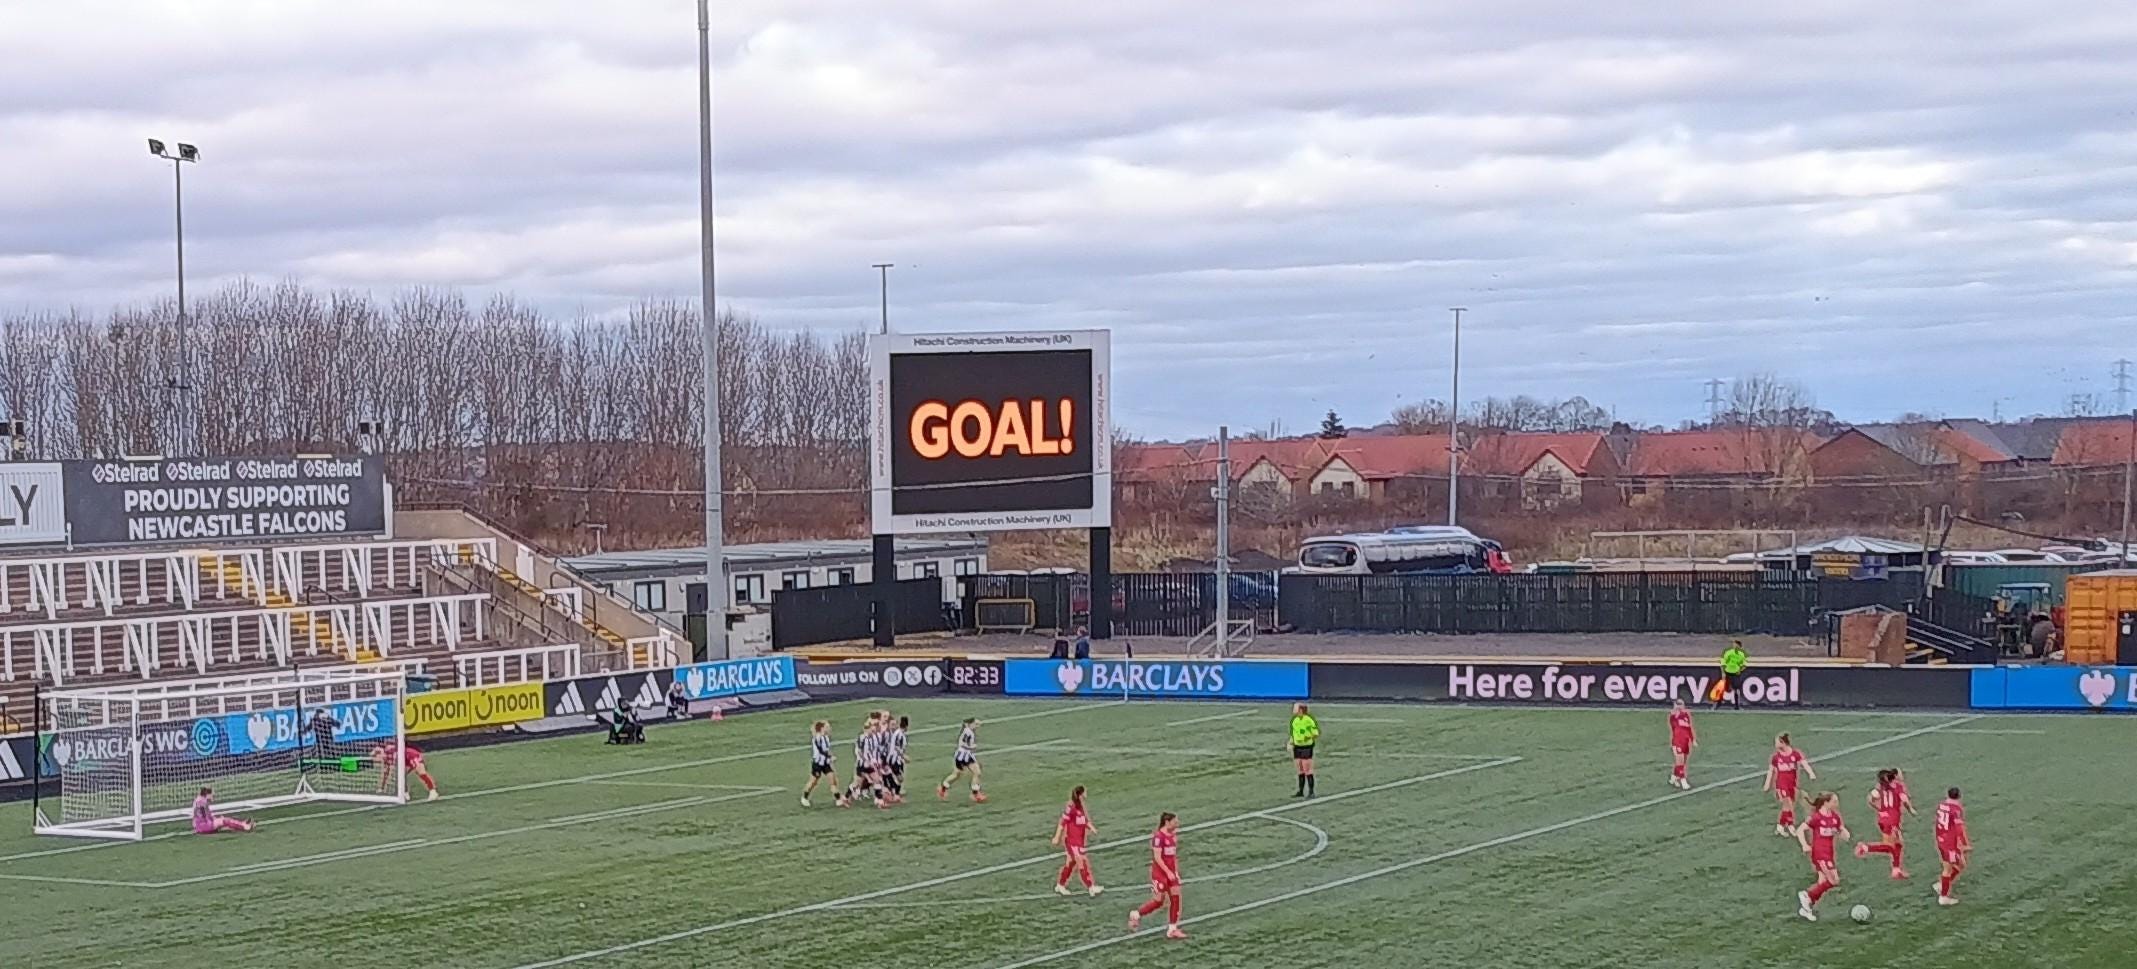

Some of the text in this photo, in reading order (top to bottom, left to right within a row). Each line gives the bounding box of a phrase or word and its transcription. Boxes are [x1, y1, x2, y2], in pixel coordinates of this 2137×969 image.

[913, 338, 945, 347] Hitachi
[947, 336, 1004, 346] Construction
[1005, 335, 1050, 345] Machinery
[909, 396, 1076, 460] GOAL!
[104, 459, 362, 482] Stelrad Stelrad Stelrad Stelrad
[124, 483, 349, 513] PROUDLY SUPPORTING
[128, 510, 347, 541] NEWCASTLE FALCONS
[915, 518, 946, 527] Hitachi
[948, 516, 1004, 526] Construction
[1006, 515, 1050, 525] Machinery
[707, 660, 783, 692] BARCLAYS
[798, 671, 879, 685] FOLLOW US ON
[953, 666, 999, 685] 82:33
[1091, 664, 1224, 692] BARCLAYS
[1449, 665, 1799, 704] Here for every oal
[422, 699, 468, 722] noon
[496, 691, 540, 713] noon
[156, 730, 188, 752] WC
[1883, 790, 1894, 808] 11
